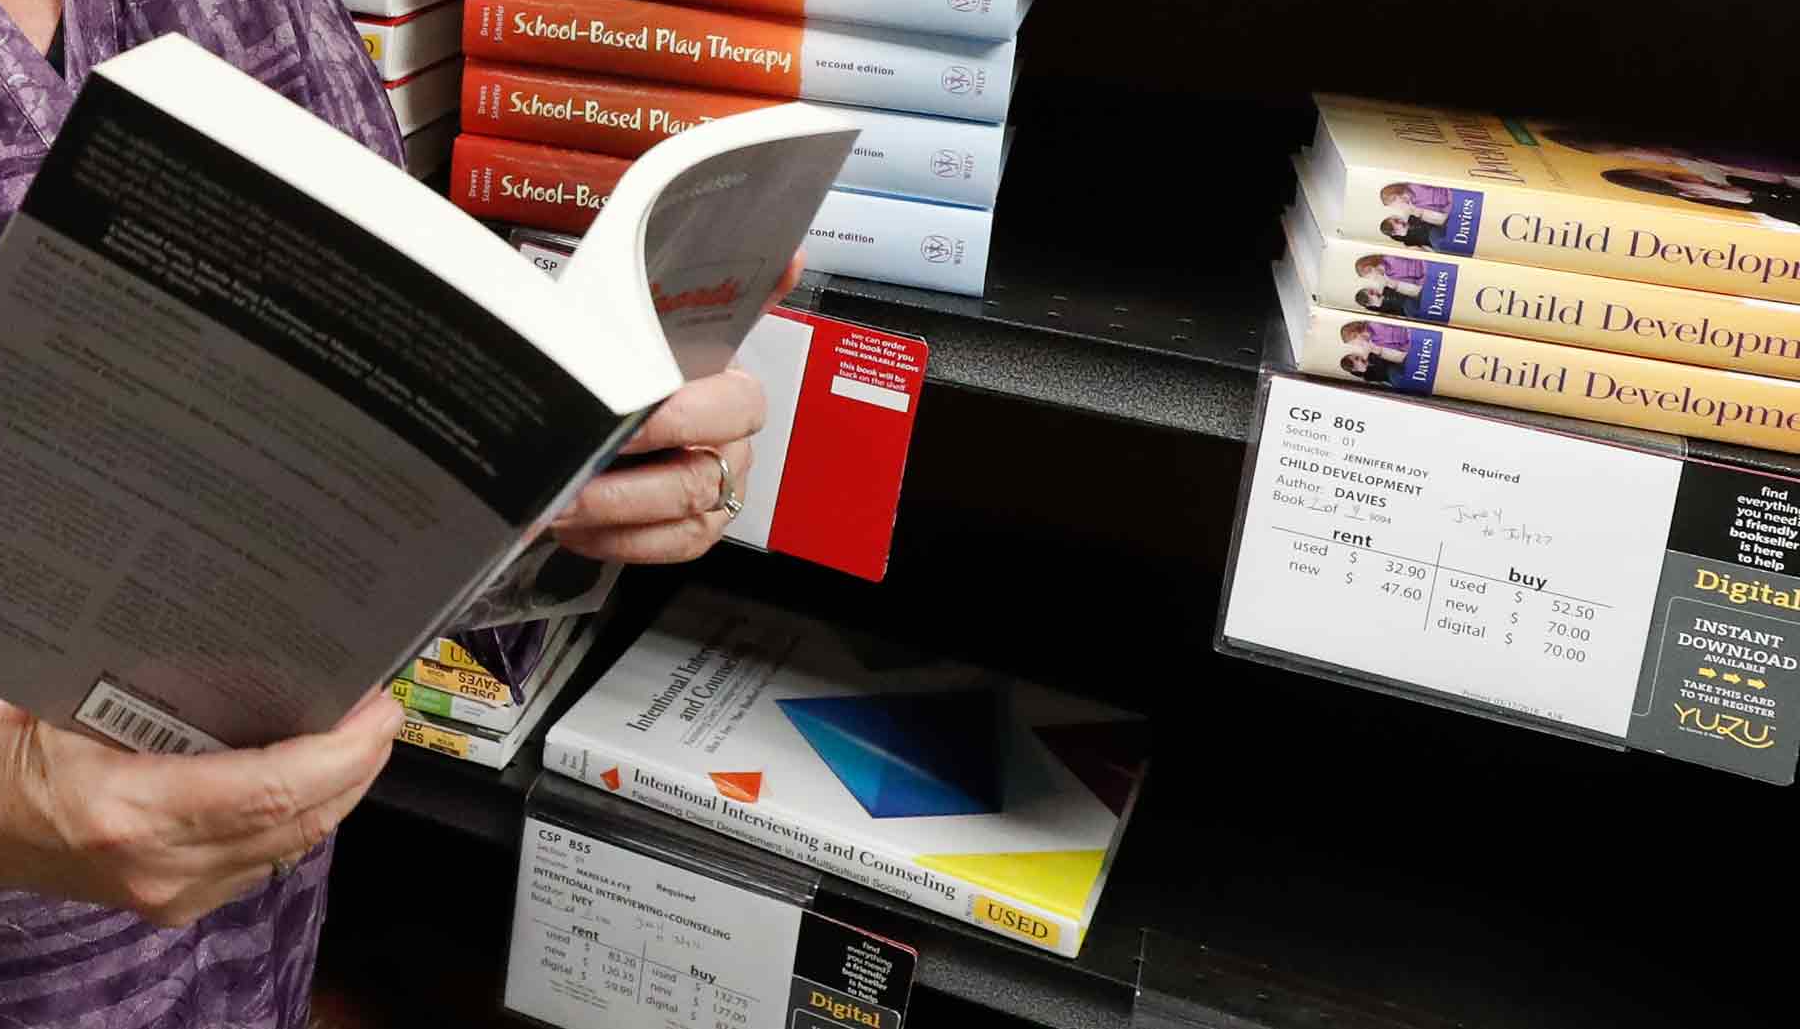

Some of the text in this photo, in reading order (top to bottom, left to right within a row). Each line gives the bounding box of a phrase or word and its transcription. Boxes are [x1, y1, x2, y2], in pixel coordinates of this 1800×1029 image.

[514, 12, 793, 73] School-Based Play Therapy
[509, 92, 641, 130] School-Based
[1454, 198, 1474, 246] Davies
[1500, 212, 1610, 254] Child
[1428, 271, 1449, 318] Davies
[1474, 285, 1585, 327] Child
[859, 342, 914, 362] book you
[882, 340, 906, 350] order
[1413, 338, 1433, 384] Davies
[1459, 353, 1567, 395] Child
[1289, 407, 1365, 434] CSP 805
[1280, 456, 1423, 496] CHILD DEVELOPMENT
[1344, 453, 1393, 470] JENNIFER
[1461, 462, 1521, 484] Required
[1334, 488, 1387, 508] DAVIES
[1333, 530, 1373, 547] rent
[1385, 560, 1426, 580] 32.90
[1508, 567, 1548, 593] buy
[1381, 582, 1422, 601] 47.60
[1694, 569, 1800, 611] Digital
[1551, 599, 1595, 621] 52.50
[1547, 621, 1591, 642] 70.00
[1694, 618, 1783, 649] INSTANT
[1678, 633, 1797, 671] DOWNLOAD
[1674, 703, 1774, 749] YUZU
[538, 829, 592, 855] CSP 855
[634, 768, 956, 900] Intentional Interviewing and Counseling
[806, 852, 913, 900] Multicultural Society
[571, 893, 593, 908] IVEY
[571, 923, 600, 942] rent
[986, 902, 1049, 940] USED
[808, 990, 881, 1029] Digital
